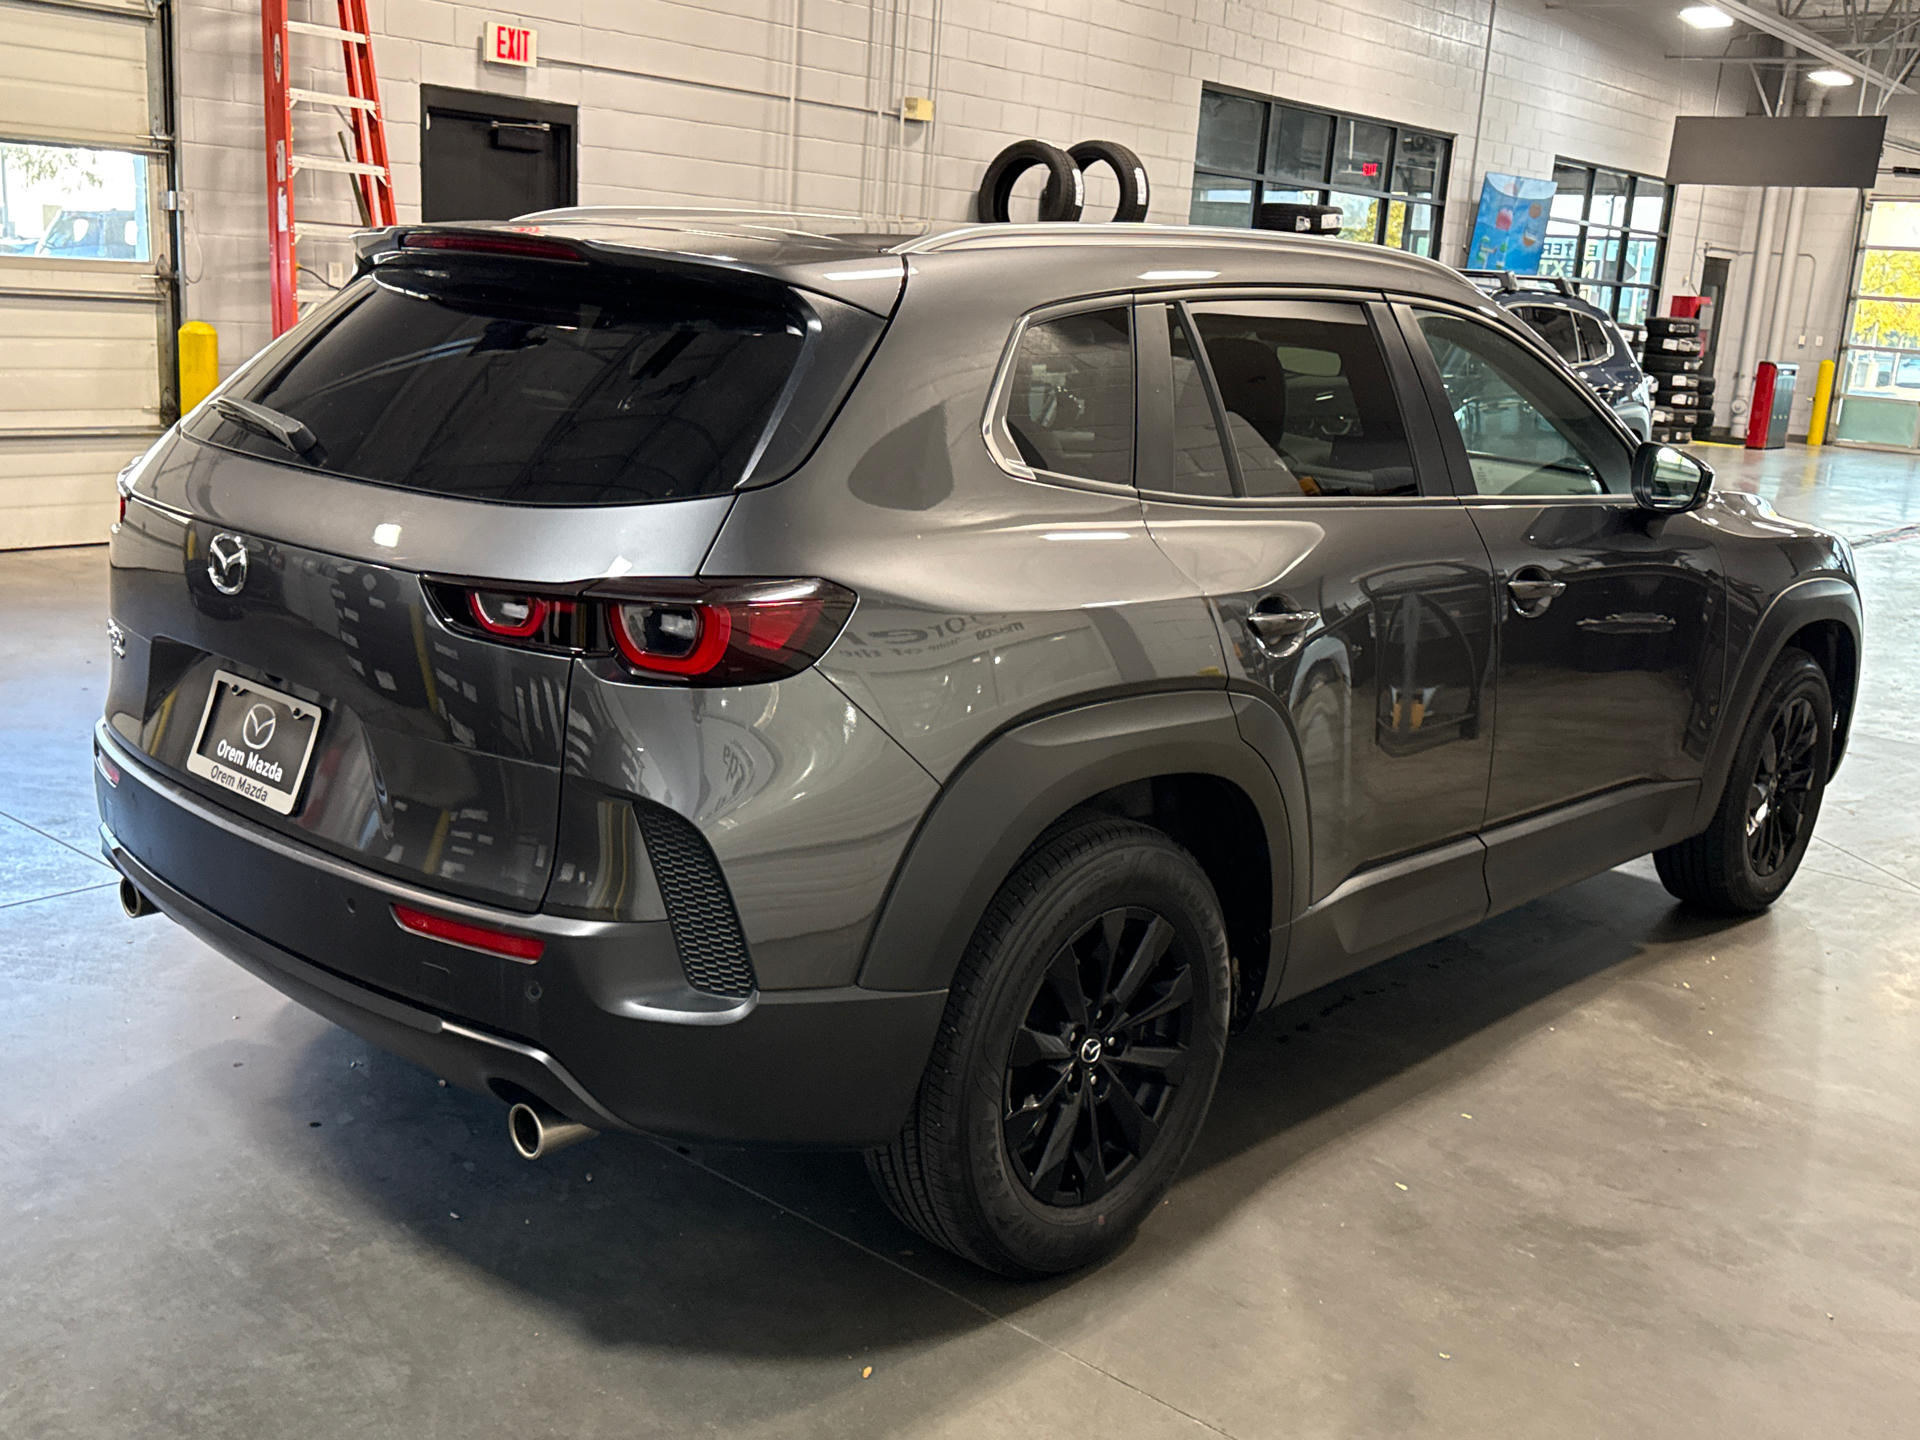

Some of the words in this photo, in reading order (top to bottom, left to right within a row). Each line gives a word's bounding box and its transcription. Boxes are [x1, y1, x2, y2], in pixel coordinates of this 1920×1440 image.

[497, 25, 530, 62] EXIT
[216, 739, 245, 766] Orem
[246, 752, 284, 783] Mazda
[210, 765, 235, 787] Orem
[236, 776, 268, 802] Mazda
